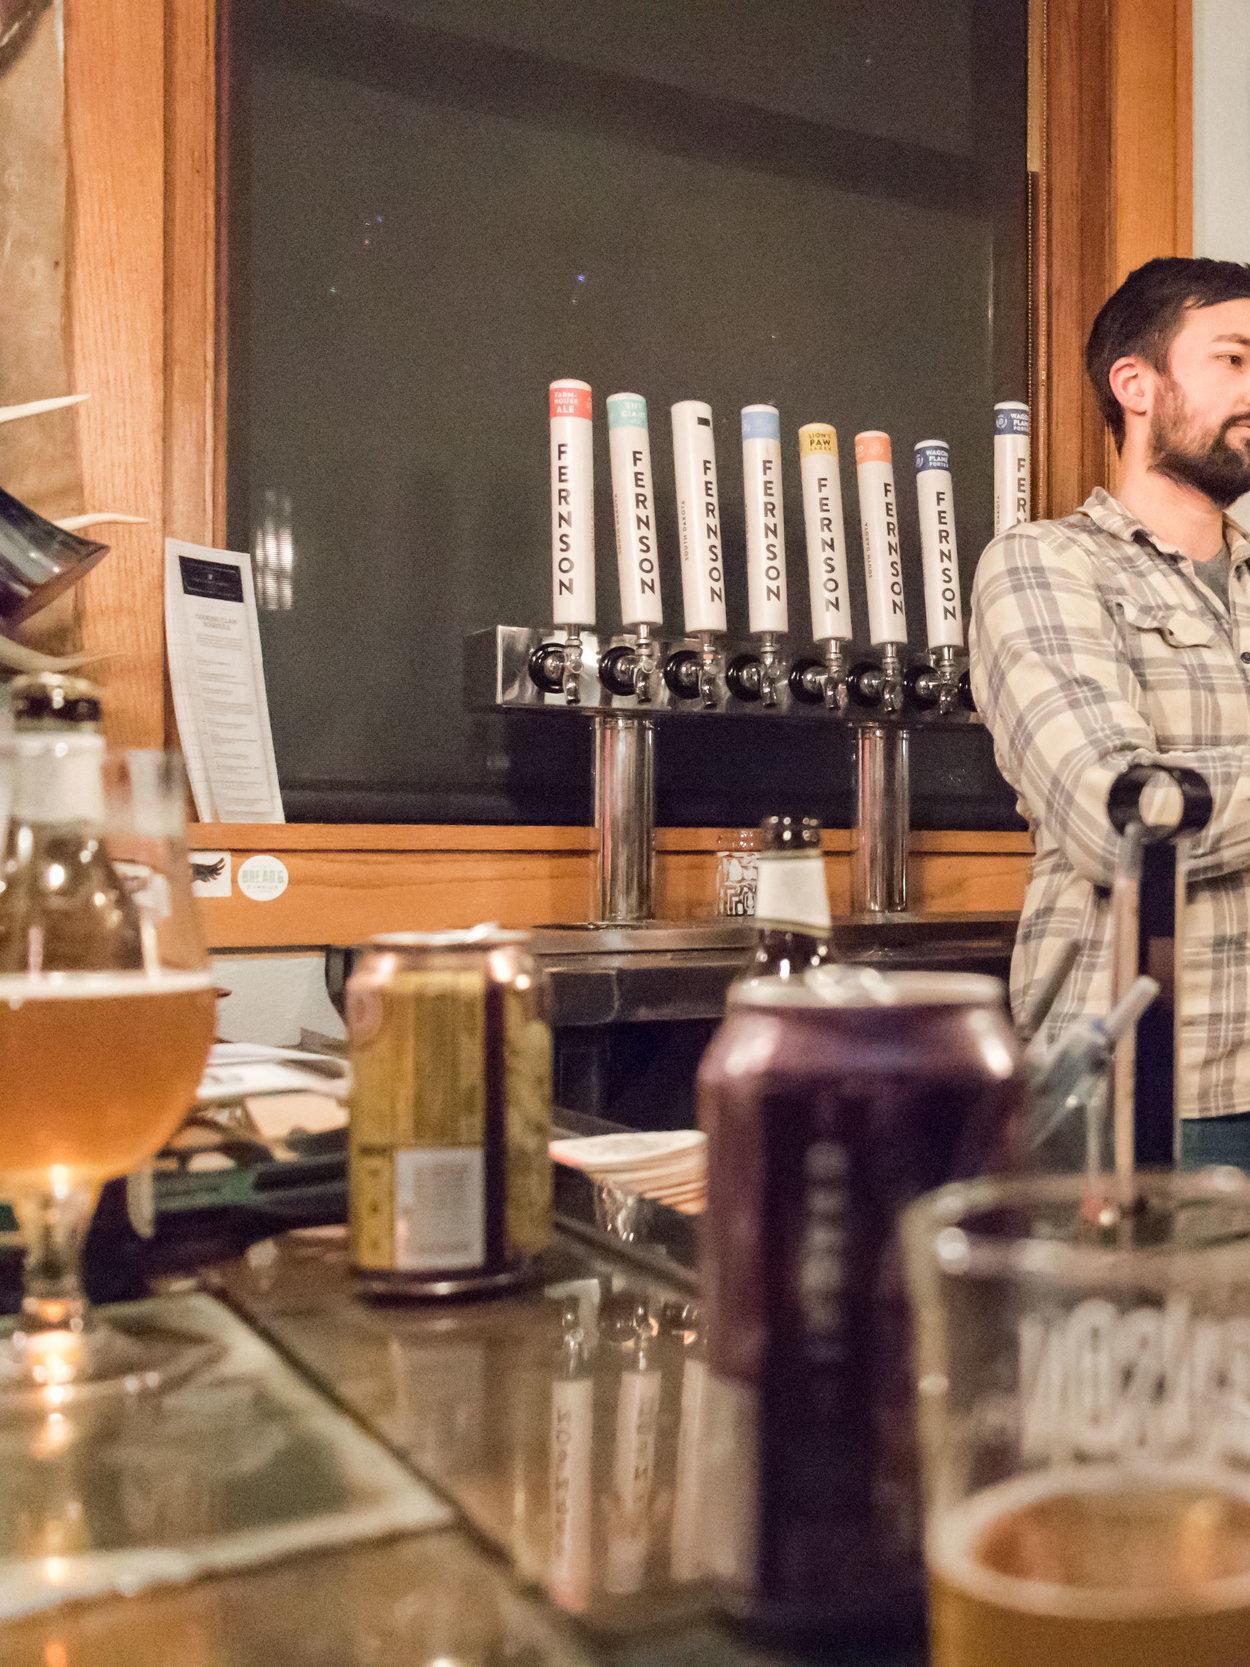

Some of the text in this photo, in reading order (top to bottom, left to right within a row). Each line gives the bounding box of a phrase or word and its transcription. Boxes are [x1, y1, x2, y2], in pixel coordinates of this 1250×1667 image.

[556, 405, 575, 414] ALE
[557, 443, 575, 596] FERNSON
[632, 450, 656, 596] FERNSON
[680, 500, 688, 532] DAKOTA
[702, 459, 723, 604] FERNSON
[762, 459, 781, 602] FERNSON
[817, 477, 841, 613] FERNSON
[883, 482, 904, 616] FERNSON
[936, 491, 957, 621] FERNSON
